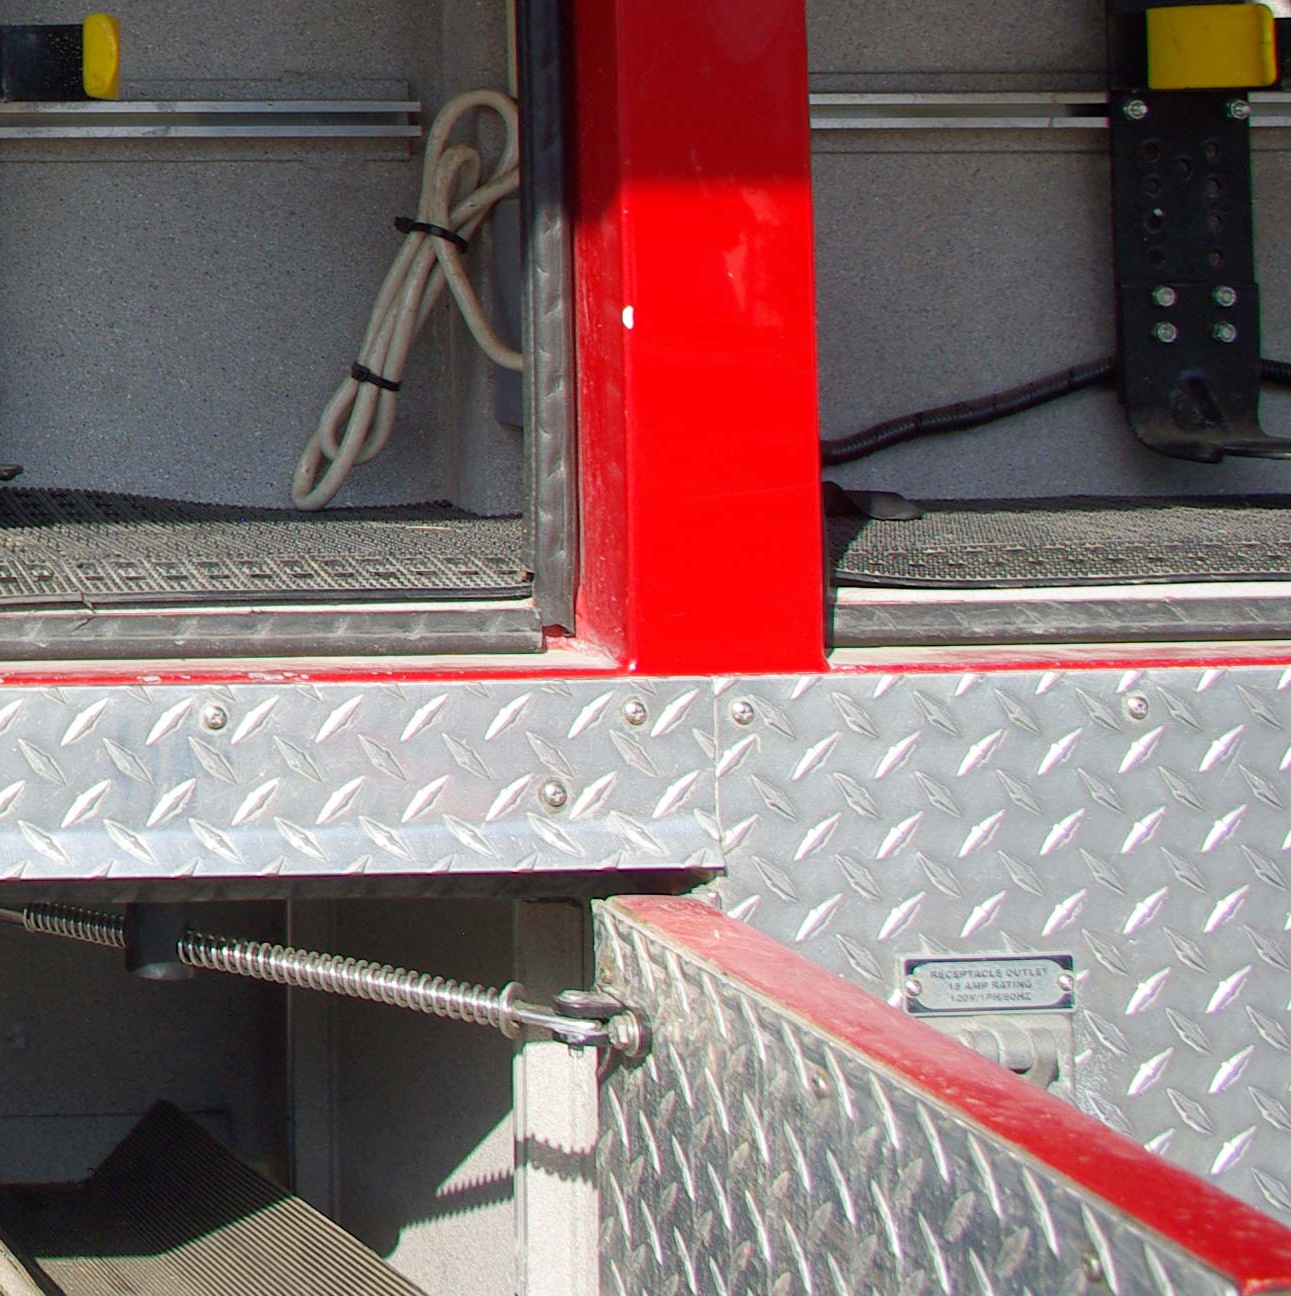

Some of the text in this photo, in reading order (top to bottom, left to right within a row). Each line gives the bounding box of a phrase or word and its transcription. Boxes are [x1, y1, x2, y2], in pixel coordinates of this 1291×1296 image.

[930, 967, 1049, 980] RECEPTACLE OUTLET
[965, 981, 988, 990] AMP
[991, 979, 1033, 989] RATING
